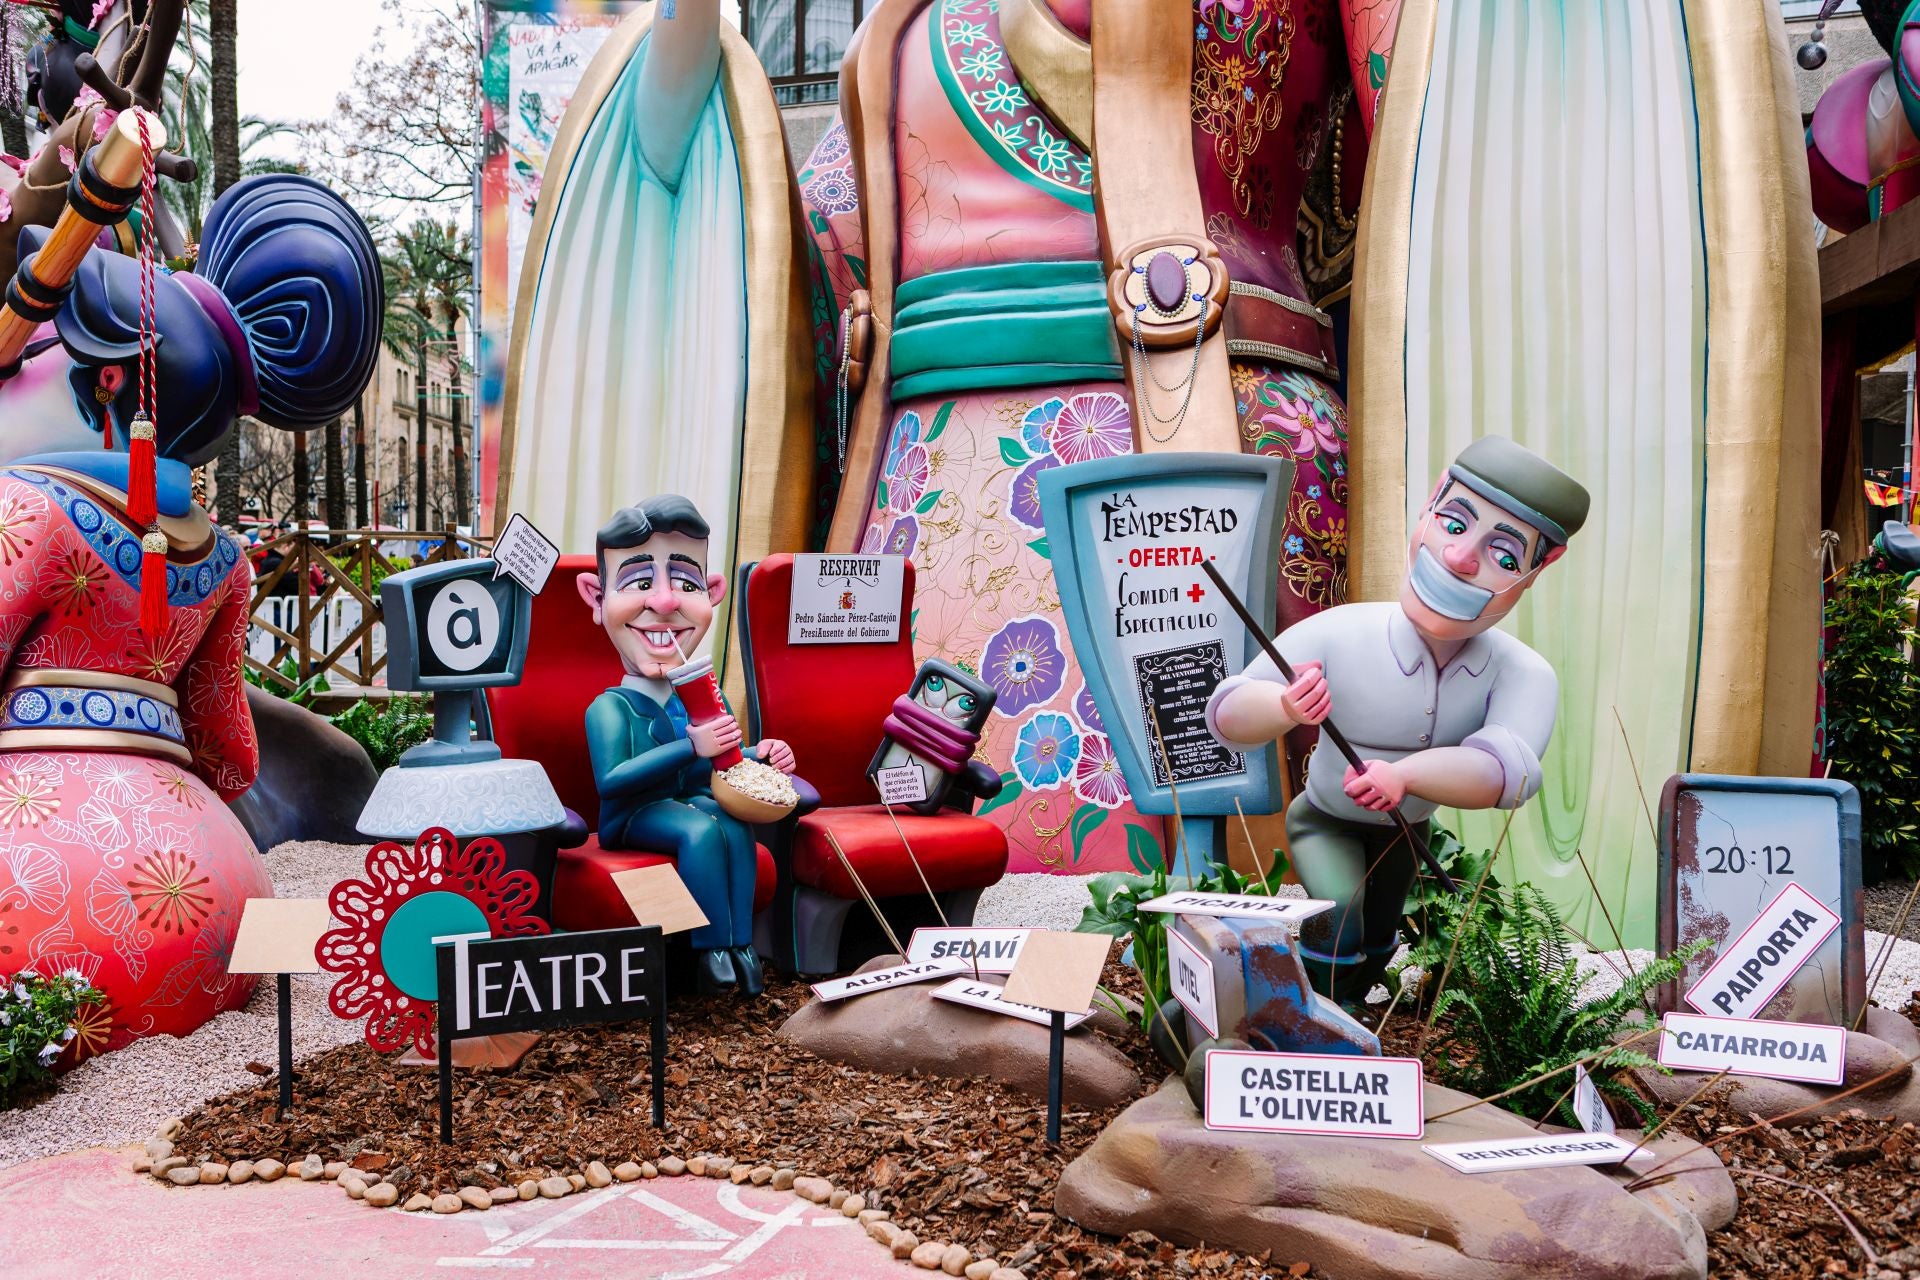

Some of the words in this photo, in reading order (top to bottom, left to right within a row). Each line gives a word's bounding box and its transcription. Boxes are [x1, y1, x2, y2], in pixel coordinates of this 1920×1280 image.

[526, 44, 544, 59] VA
[552, 41, 561, 53] A
[525, 54, 578, 76] APAGAR
[1112, 493, 1137, 508] LA
[819, 560, 880, 576] RESERVAT
[1129, 547, 1203, 568] OFERTA
[1119, 572, 1178, 608] COMIDA
[795, 613, 814, 623] Pedro
[818, 612, 845, 623] Sánchez
[848, 612, 897, 624] Pérez-Castejón
[1116, 607, 1218, 637] ESPECTACULO
[848, 628, 858, 637] del
[860, 628, 889, 637] Gobierno
[1706, 845, 1794, 874] 20:12
[1173, 897, 1292, 912] PICANYA
[930, 936, 1021, 959] SEDAVÍ
[1712, 908, 1818, 1014] PAIPORTA
[431, 932, 646, 1030] TEATRE
[845, 963, 942, 989] ALDAYA
[1178, 958, 1201, 1004] UTIEL
[962, 987, 989, 998] LA
[1676, 1031, 1827, 1063] CATARROJA
[1241, 1068, 1389, 1095] CASTELLAR
[1240, 1096, 1392, 1125] L'OLIVERAL
[1457, 1141, 1620, 1160] BENETÚSSER
